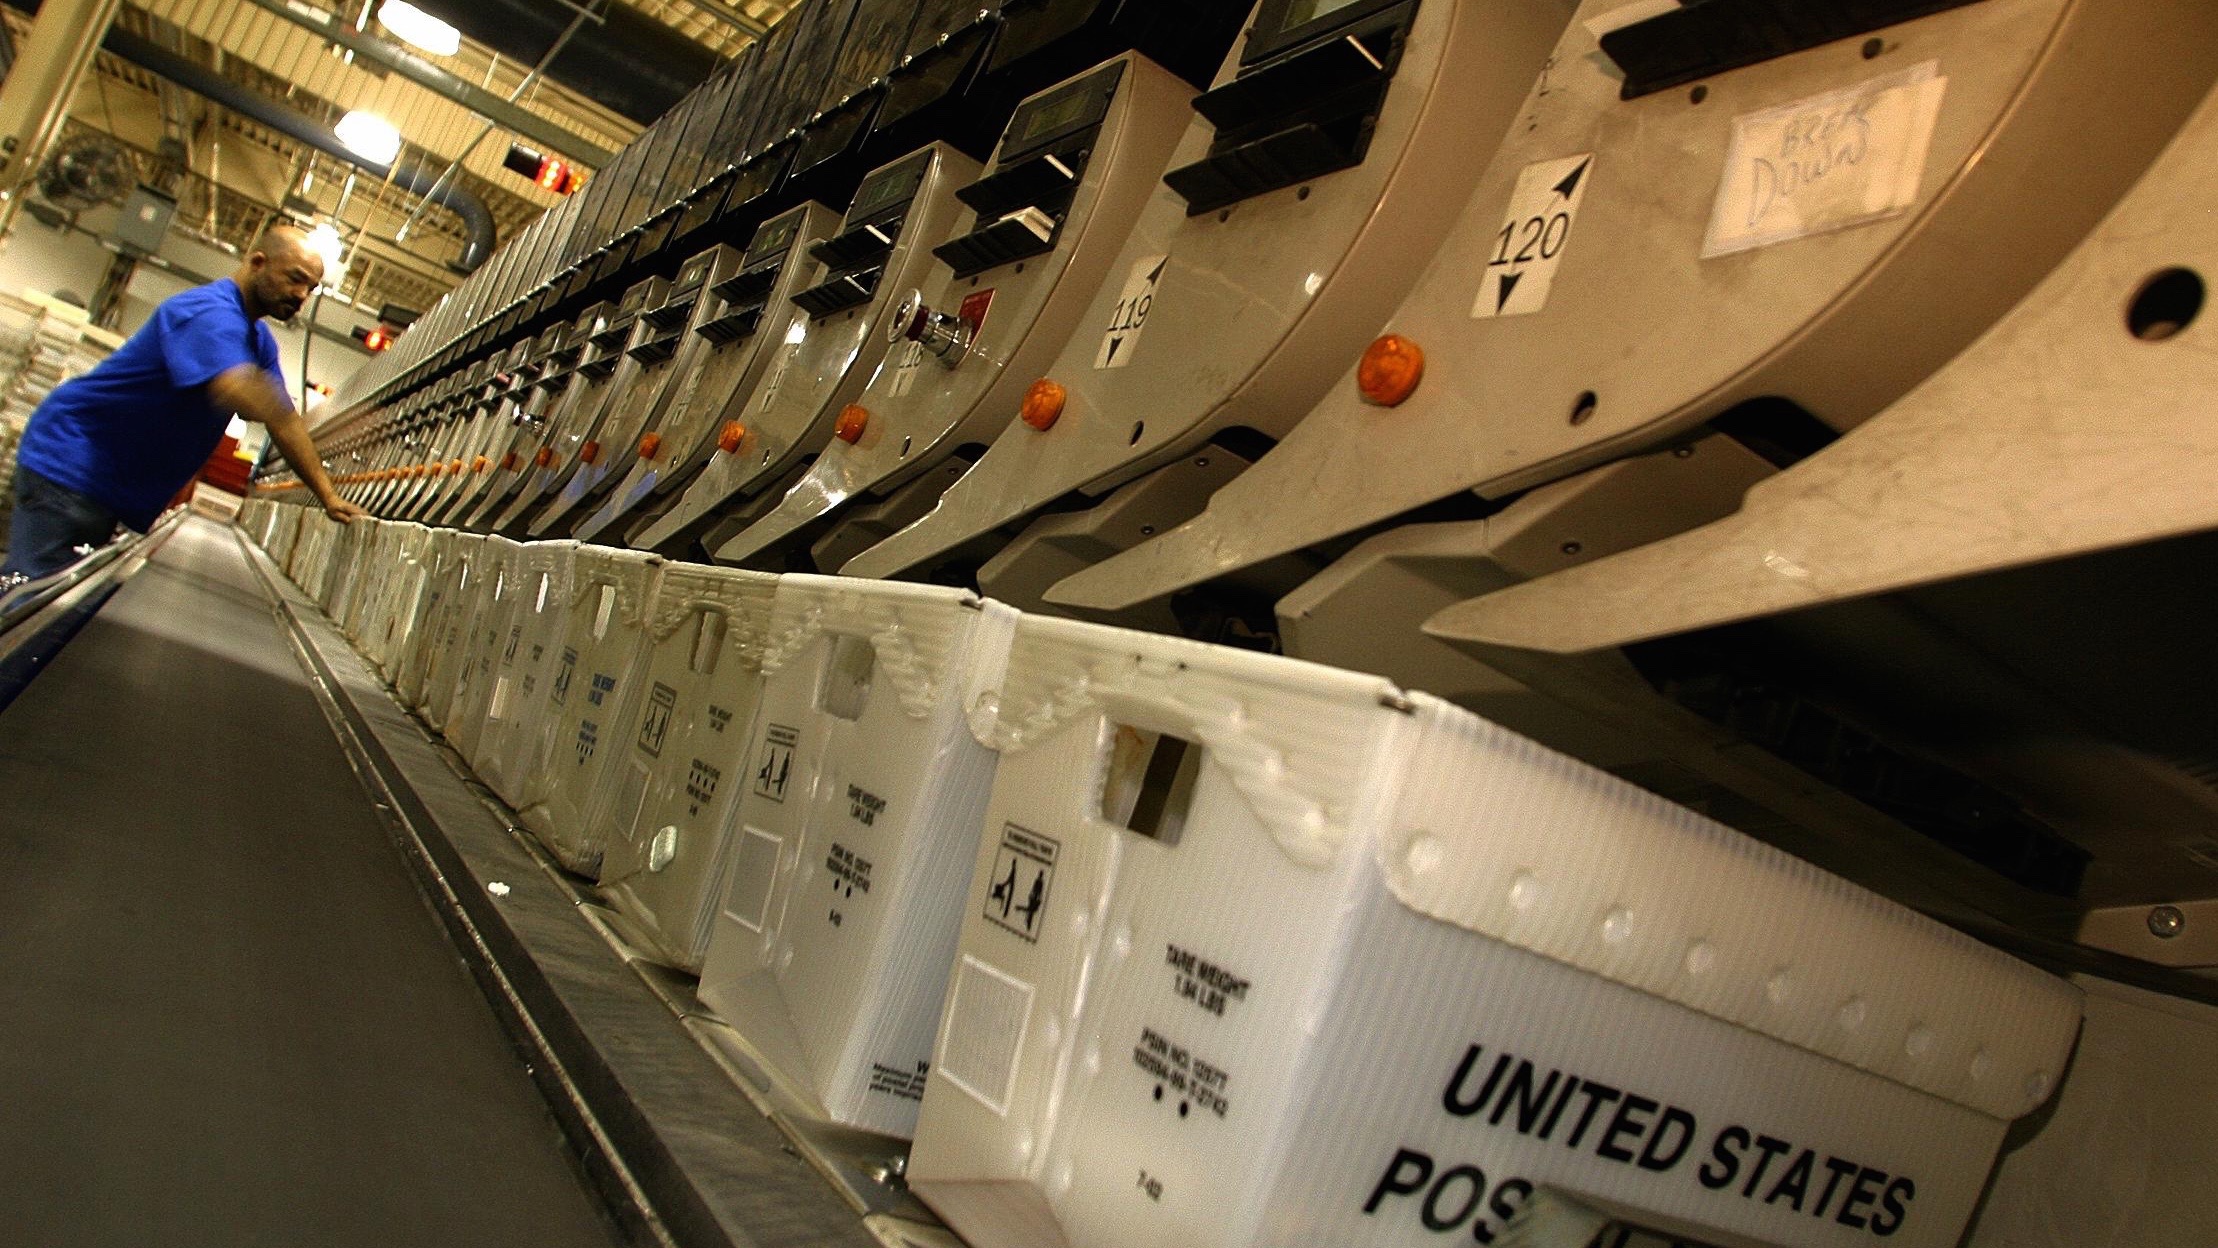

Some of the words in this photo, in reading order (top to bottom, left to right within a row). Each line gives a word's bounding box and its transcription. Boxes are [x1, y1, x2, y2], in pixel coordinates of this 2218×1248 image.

[1488, 211, 1569, 266] 120
[1107, 295, 1152, 332] 119
[1442, 1044, 1697, 1172] UNITED
[1698, 1125, 1916, 1237] STATES
